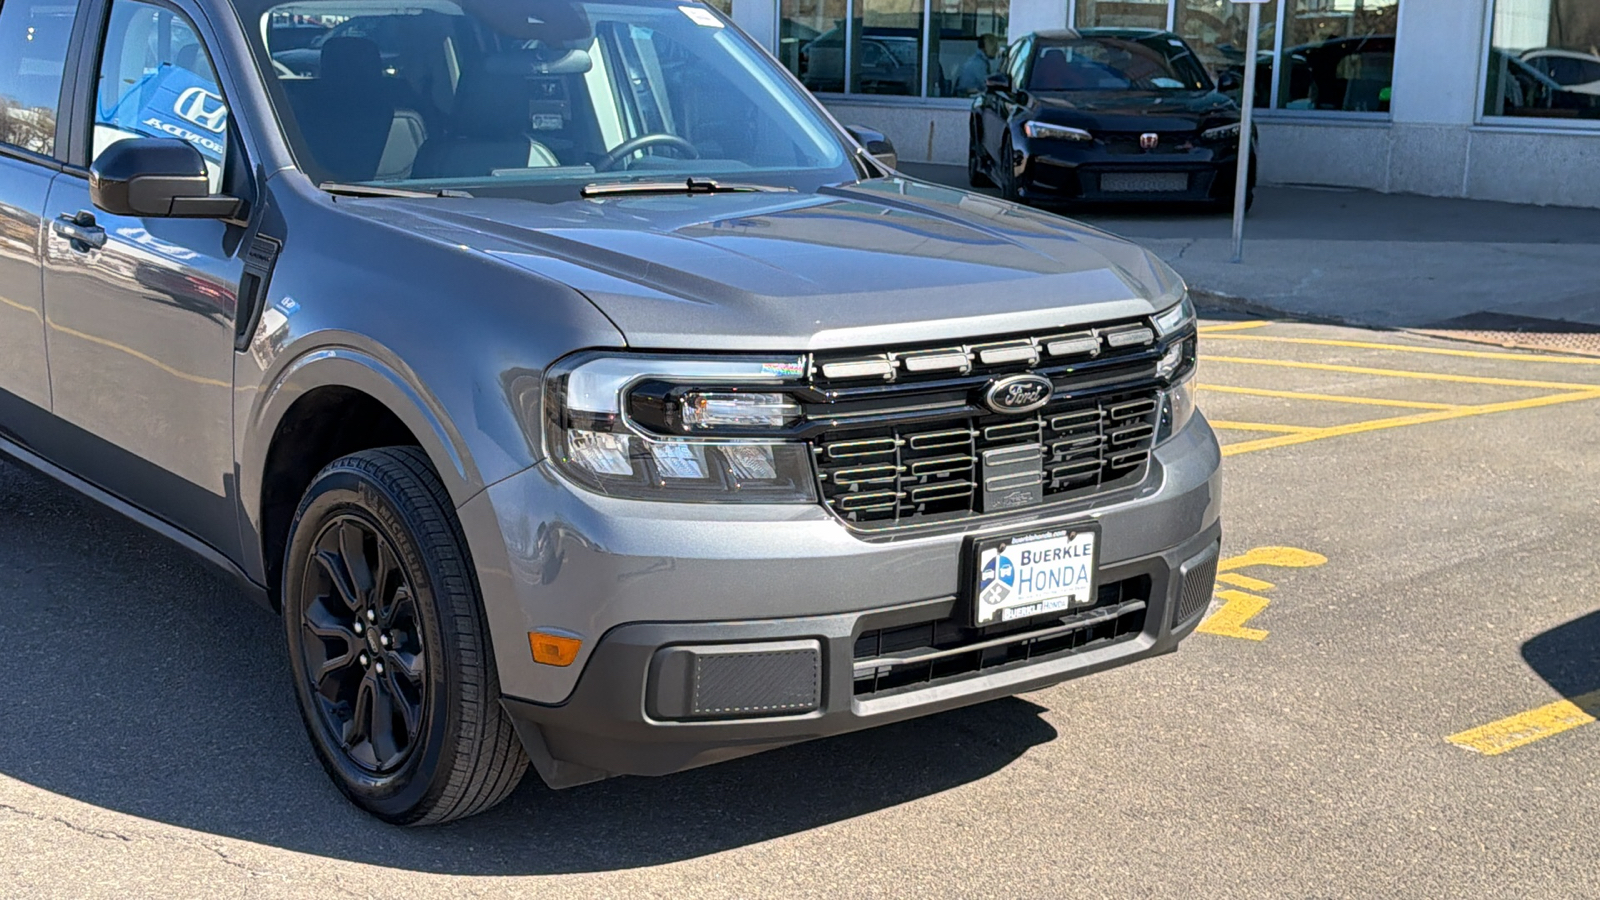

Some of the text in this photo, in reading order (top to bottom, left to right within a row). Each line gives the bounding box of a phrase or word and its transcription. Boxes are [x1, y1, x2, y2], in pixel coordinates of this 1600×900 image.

[1005, 383, 1042, 405] Ford
[379, 505, 425, 585] MICHELIN
[1020, 543, 1091, 566] BUERKLE
[1018, 564, 1089, 595] HONDA
[1003, 602, 1043, 620] BUERKLE
